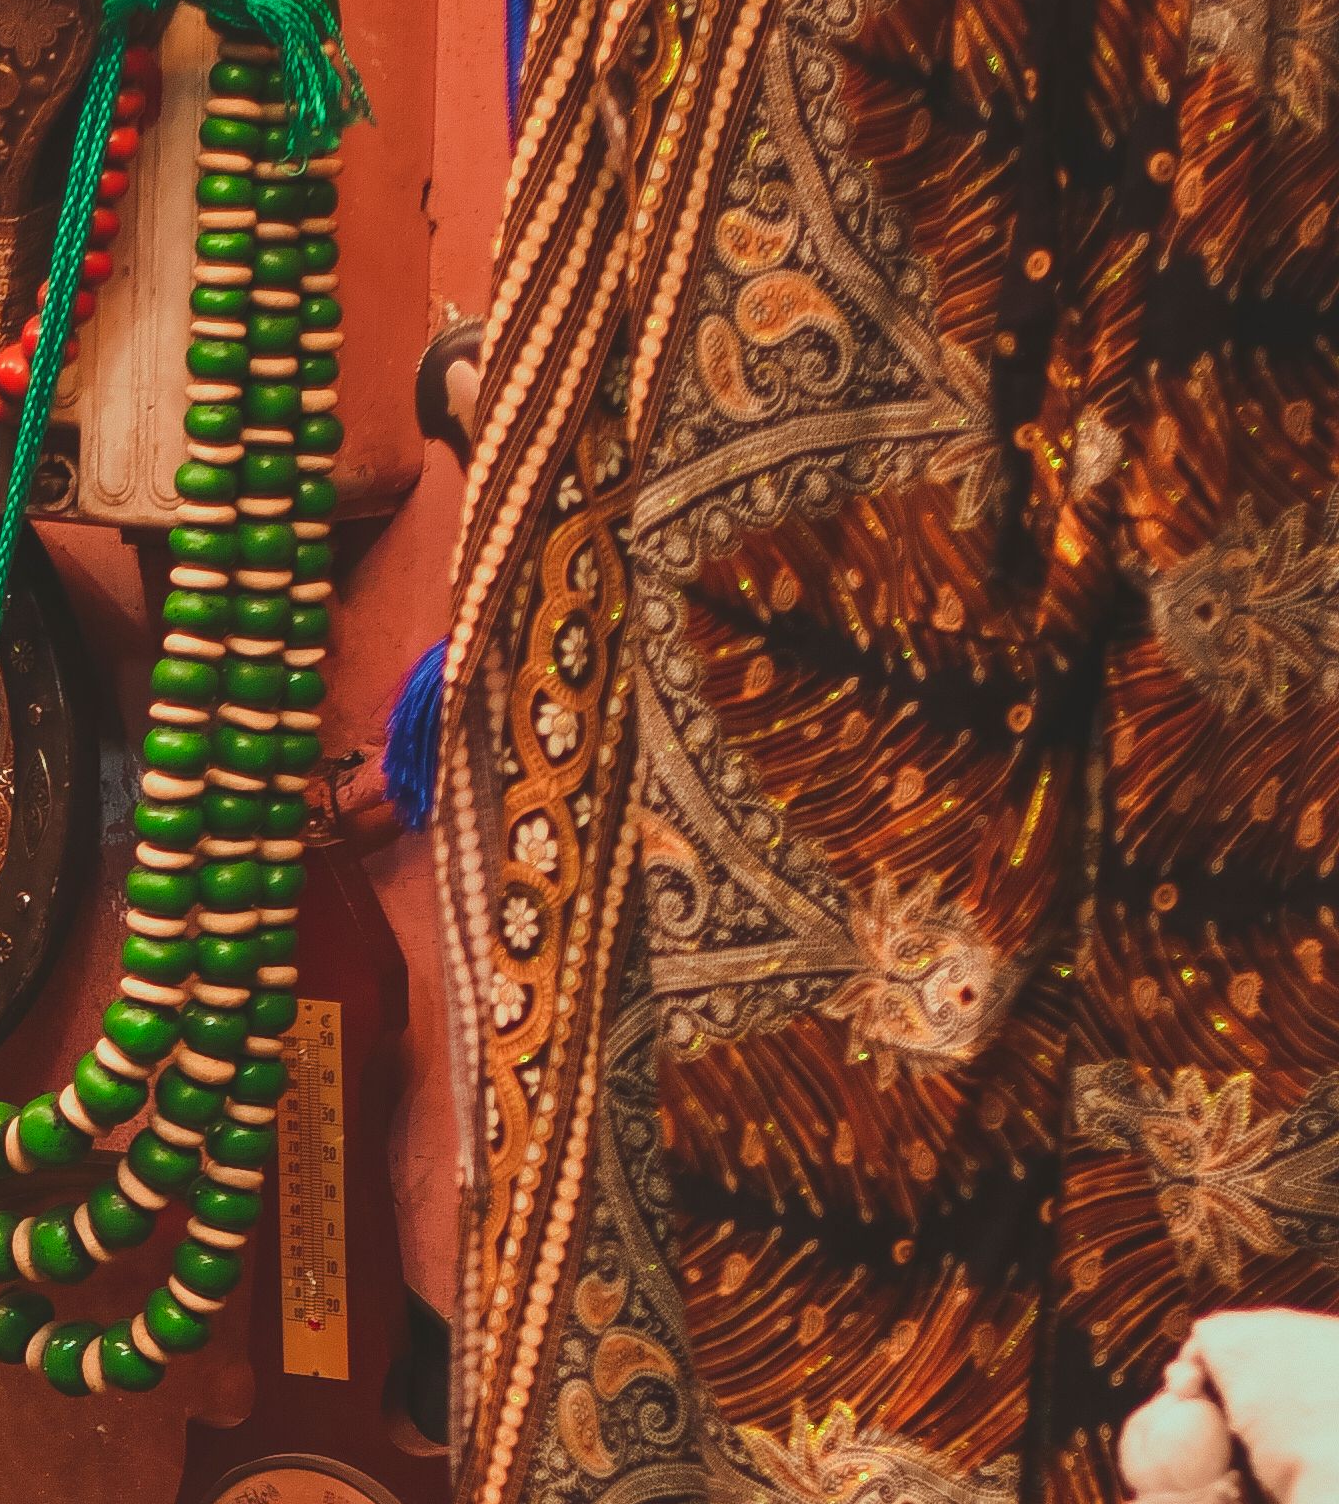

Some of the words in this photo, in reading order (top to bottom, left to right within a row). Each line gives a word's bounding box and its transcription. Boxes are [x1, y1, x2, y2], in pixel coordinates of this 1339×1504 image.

[319, 1031, 335, 1046] 50
[321, 1069, 335, 1085] 40
[321, 1108, 336, 1123] 30
[322, 1145, 336, 1161] 20
[324, 1184, 336, 1199] 10
[326, 1221, 335, 1237] 0
[326, 1259, 338, 1275] 10
